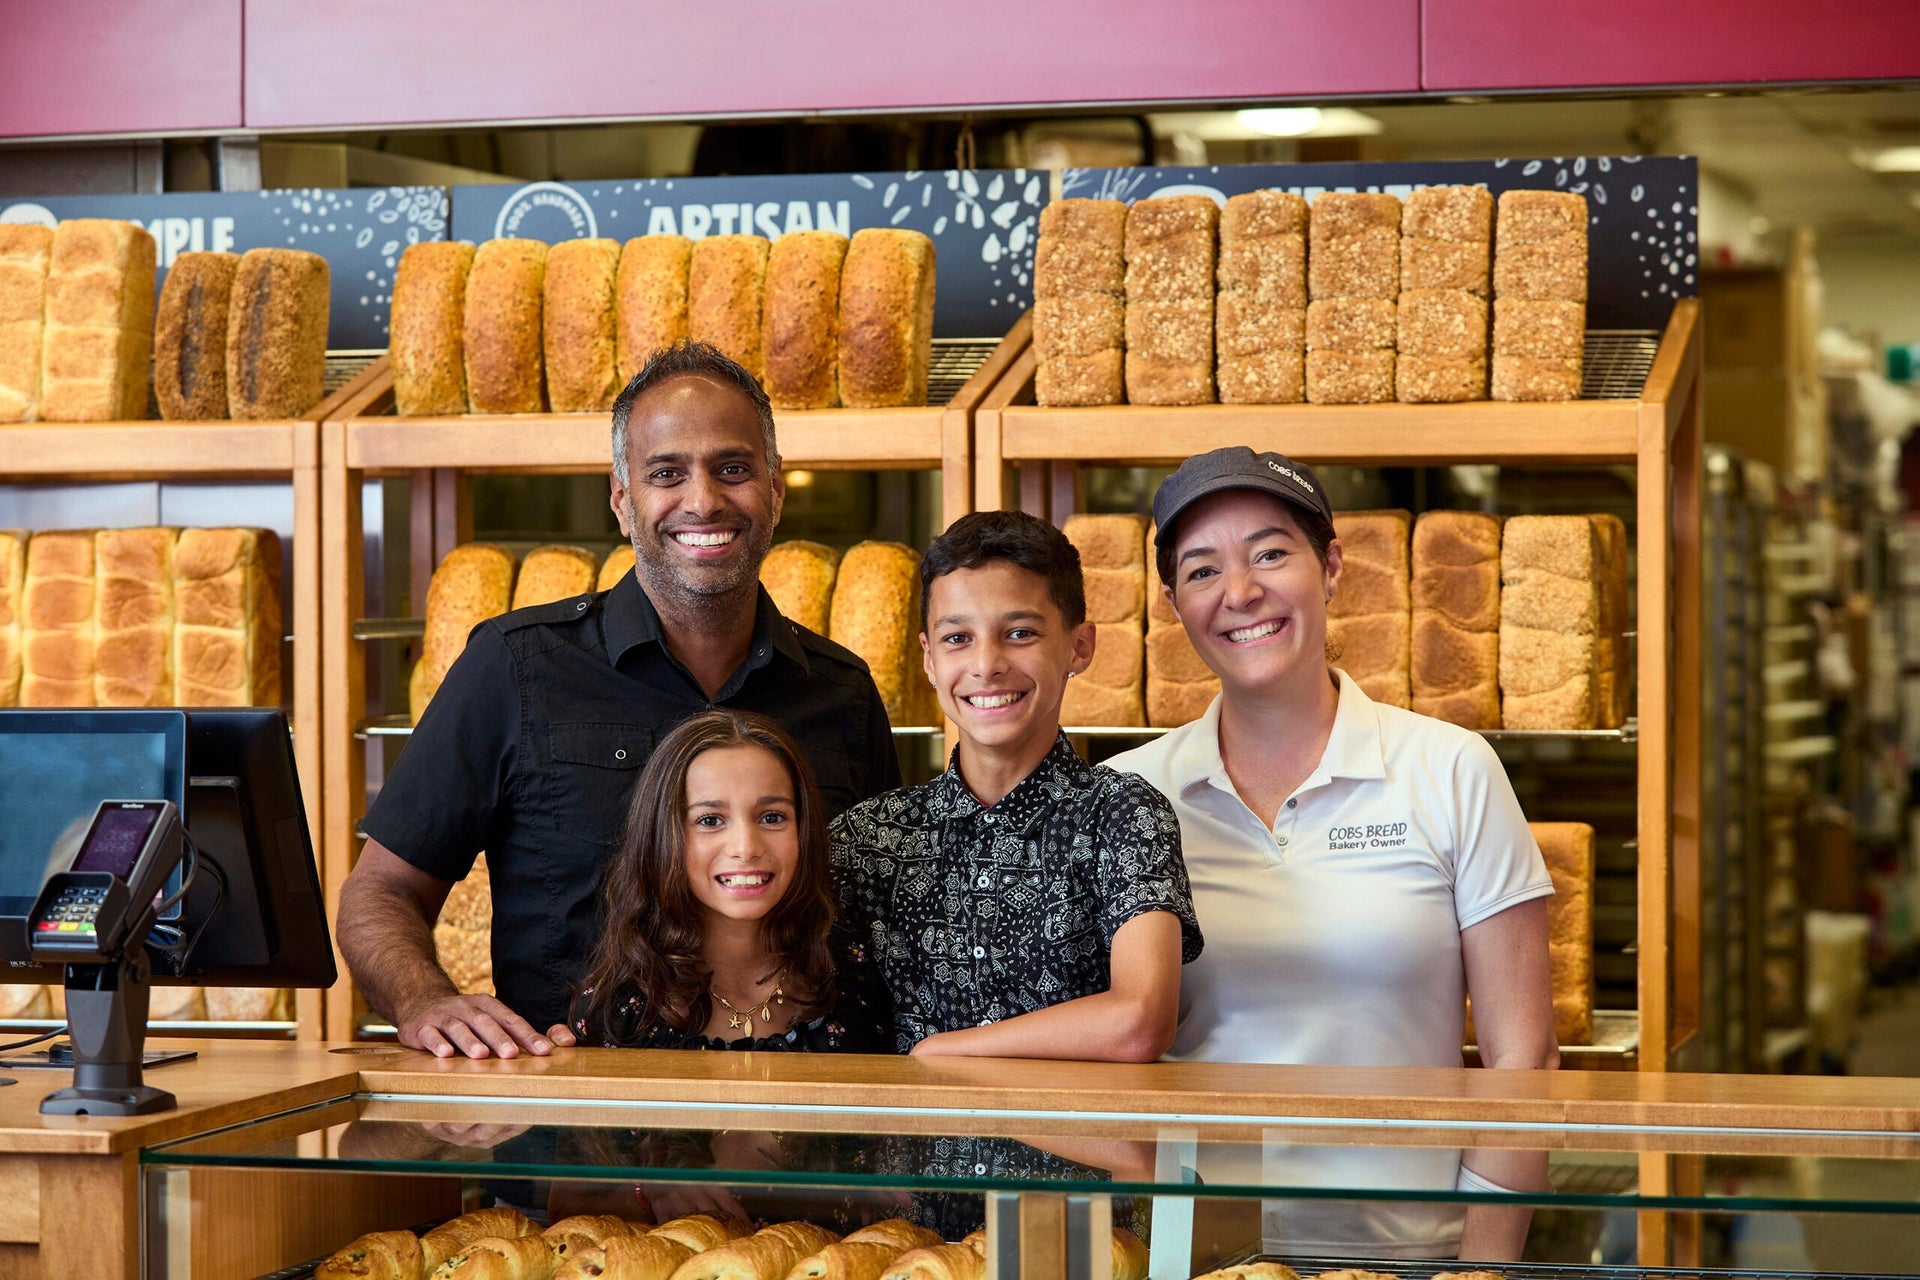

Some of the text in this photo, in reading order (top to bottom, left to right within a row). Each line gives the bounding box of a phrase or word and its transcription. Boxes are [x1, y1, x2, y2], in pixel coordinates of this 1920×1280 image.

[647, 200, 850, 243] ARTISAN
[1268, 461, 1292, 477] COBS
[1328, 822, 1408, 841] COBS BREAD
[1329, 838, 1406, 850] Bakery Owner
